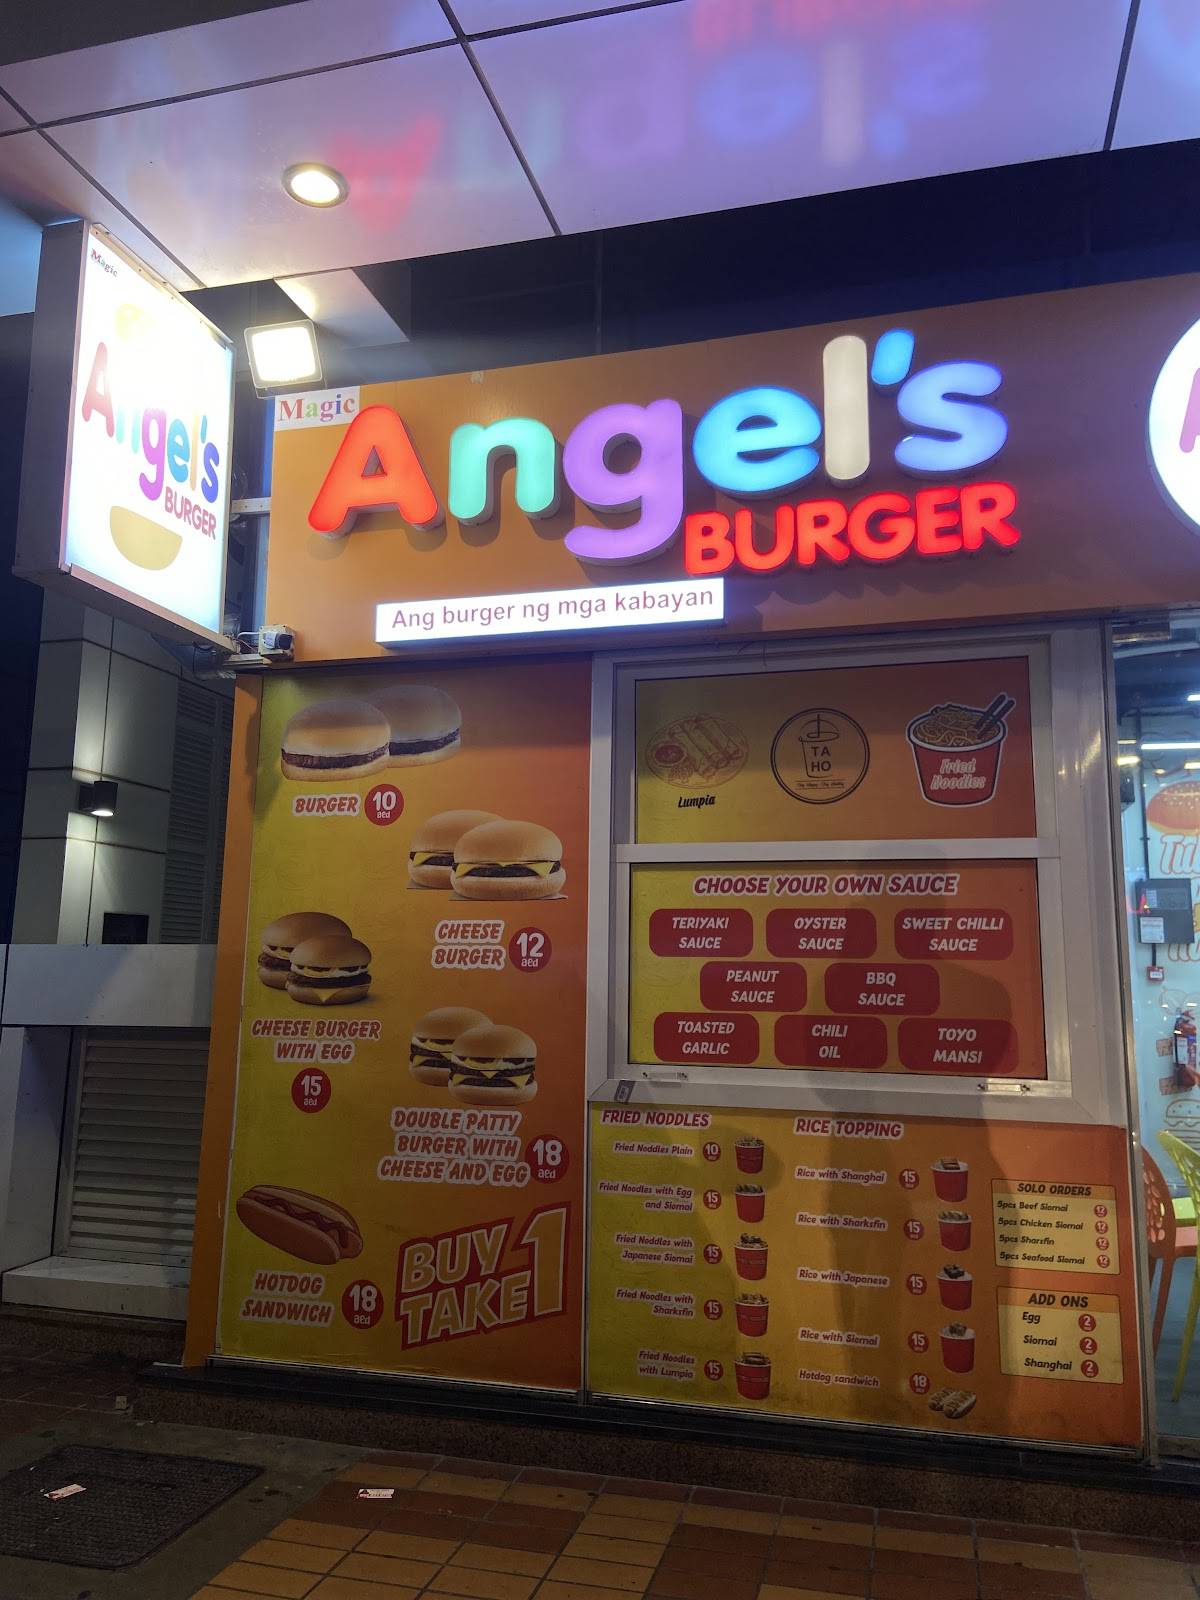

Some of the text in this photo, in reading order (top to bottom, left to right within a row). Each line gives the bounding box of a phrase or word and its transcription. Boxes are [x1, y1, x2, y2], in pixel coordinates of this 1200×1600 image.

[91, 248, 118, 277] Magic
[277, 393, 356, 422] Magic
[82, 342, 220, 503] Angel's
[308, 328, 1009, 561] Angel's
[165, 486, 217, 540] BURGER
[683, 482, 1021, 575] BURGER
[392, 586, 714, 631] Ang burger ng mga kabayan
[811, 746, 831, 757] TA
[811, 761, 831, 772] HO
[939, 758, 976, 774] Fried
[930, 774, 986, 790] Noodles
[294, 796, 358, 814] BURGER
[372, 791, 396, 812] 10
[678, 794, 715, 809] Lumpia
[694, 875, 957, 895] CHOOSE YOUR OWN SAUCE
[672, 917, 729, 930] TERIYAKI
[794, 917, 847, 930] OYSTER
[902, 917, 1004, 931] SWEET CHILLI
[438, 922, 502, 940] CHEESE
[517, 932, 544, 958] 12
[678, 936, 721, 949] SAUCE
[798, 937, 844, 951] SAUCE
[928, 938, 978, 952] SAUCE
[434, 948, 502, 967] BURGER
[726, 970, 779, 983] PEANUT
[866, 972, 896, 986] BBQ
[731, 989, 775, 1003] SAUCE
[857, 992, 905, 1006] SAUCE
[251, 1019, 381, 1039] CHEESE BURGER
[677, 1020, 735, 1034] TOASTED
[811, 1024, 848, 1038] CHILI
[937, 1028, 977, 1042] TOYO
[276, 1042, 352, 1060] WITH EGG
[682, 1041, 730, 1055] GARLIC
[819, 1045, 841, 1059] OIL
[933, 1050, 983, 1064] MANSI
[301, 1075, 322, 1097] 15
[394, 1110, 519, 1131] DOUBLE PATTY
[602, 1109, 709, 1127] FRIED NODDLES
[796, 1118, 902, 1137] RICE TOPPING
[398, 1135, 519, 1157] BURGER WITH
[533, 1139, 563, 1166] 18
[614, 1143, 635, 1152] Fried
[671, 1145, 693, 1156] Plain
[705, 1145, 718, 1155] 10
[380, 1160, 528, 1183] CHEESE AND EGG
[797, 1168, 885, 1184] Rice with Shanghai
[903, 1171, 916, 1183] 15
[600, 1182, 619, 1192] Fried
[655, 1186, 674, 1195] with
[676, 1188, 692, 1199] Egg
[706, 1191, 719, 1202] 15
[1017, 1183, 1091, 1196] SOLO ORDERS
[645, 1200, 661, 1209] and
[997, 1200, 1016, 1209] 5pcs
[1019, 1201, 1038, 1210] Beef
[798, 1214, 886, 1230] Rice with Sharksfin
[907, 1222, 921, 1233] 15
[998, 1217, 1017, 1226] 5pcs
[1020, 1219, 1052, 1229] Chicken
[616, 1233, 636, 1243] Fried
[673, 1237, 693, 1247] with
[999, 1234, 1018, 1244] 5pcs
[401, 1223, 509, 1294] BUY
[622, 1251, 661, 1263] Japanese
[707, 1246, 720, 1257] 15
[1000, 1251, 1019, 1261] 5pcs
[1021, 1252, 1054, 1263] Seafood
[520, 1207, 567, 1317] 1
[255, 1272, 323, 1293] HOTDOG
[799, 1269, 888, 1286] Rice with Japanese
[910, 1277, 923, 1289] 15
[349, 1284, 377, 1312] 18
[616, 1288, 637, 1299] Fried
[674, 1293, 693, 1304] with
[1028, 1293, 1089, 1308] ADD ONS
[242, 1301, 332, 1324] SANDWICH
[400, 1269, 532, 1345] TAKE
[707, 1301, 720, 1313] 15
[1022, 1312, 1040, 1325] Egg
[1083, 1315, 1091, 1326] 2
[800, 1329, 819, 1340] Rice
[822, 1331, 843, 1342] with
[912, 1334, 925, 1346] 15
[1023, 1335, 1057, 1346] Siomai
[1084, 1338, 1092, 1349] 2
[638, 1350, 660, 1361] Fried
[639, 1365, 658, 1375] with
[708, 1362, 721, 1374] 15
[1024, 1357, 1073, 1372] Shanghai
[1086, 1361, 1093, 1372] 2
[799, 1369, 879, 1387] Hotdog sandwich
[913, 1375, 927, 1388] 18
